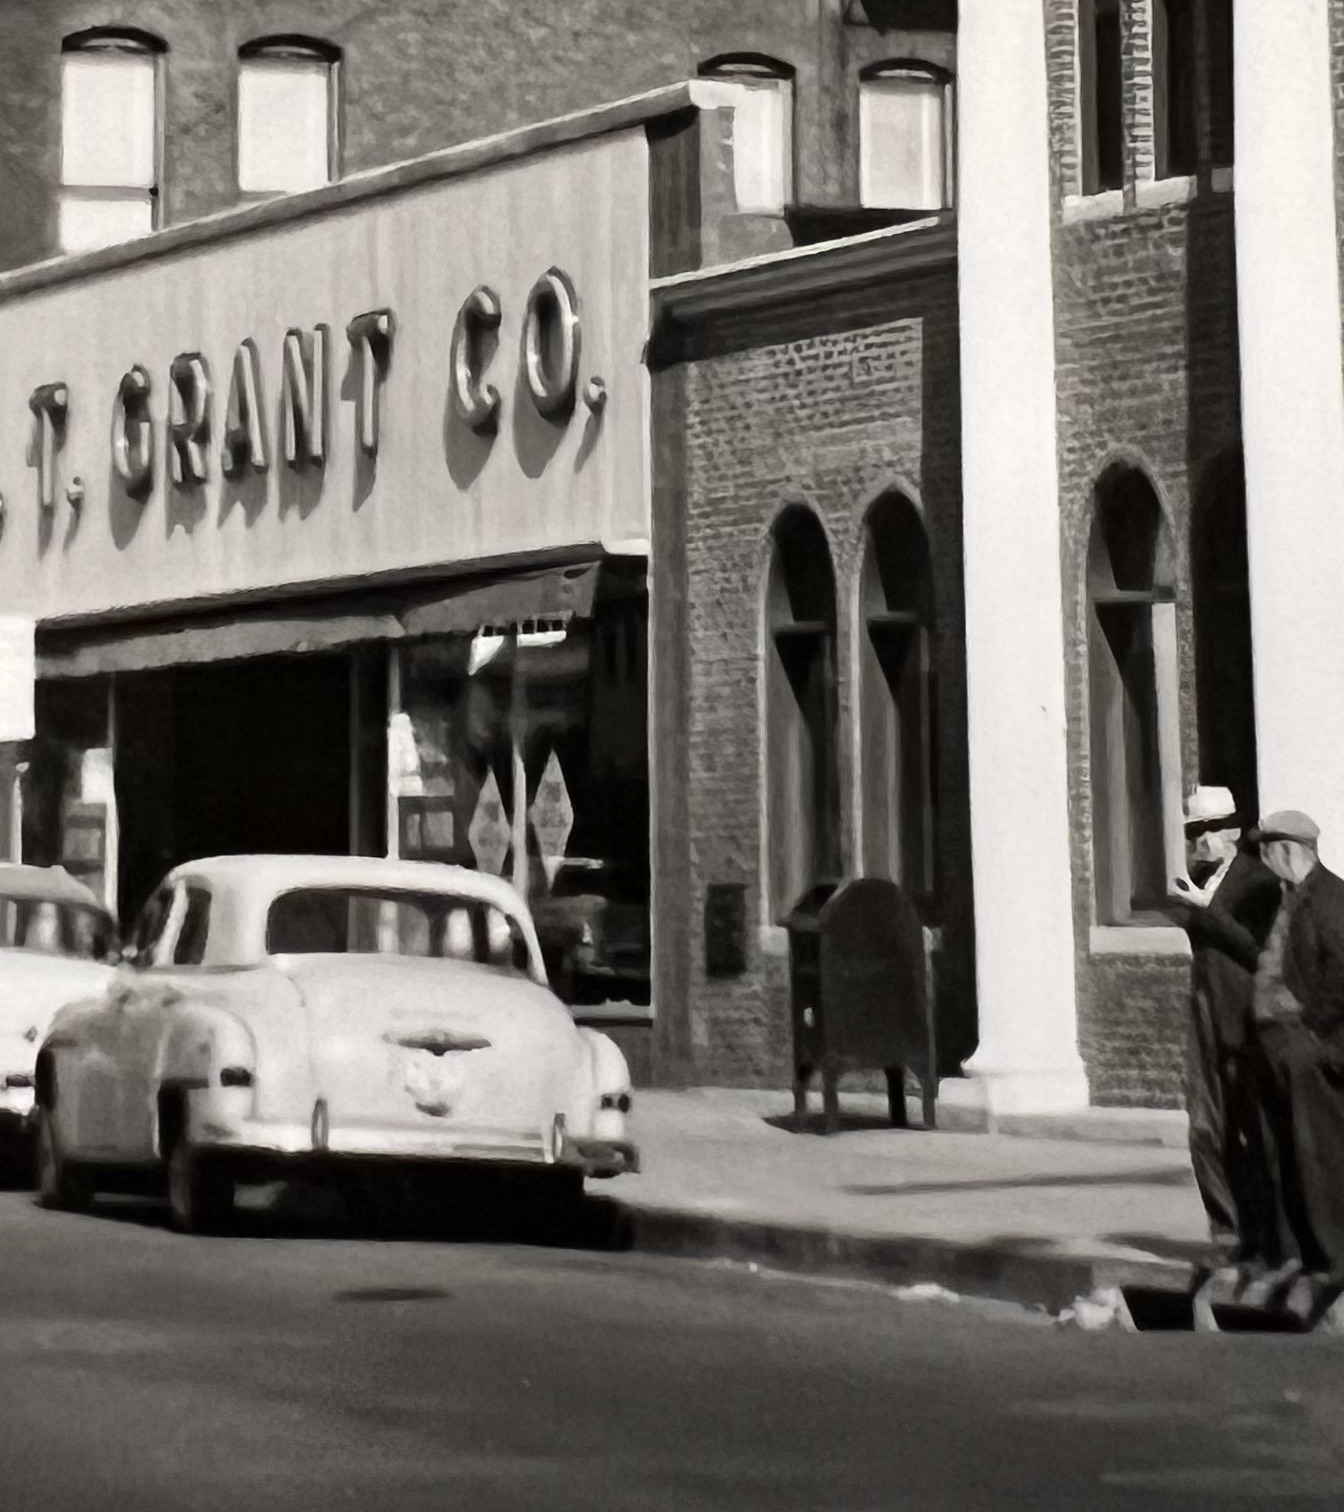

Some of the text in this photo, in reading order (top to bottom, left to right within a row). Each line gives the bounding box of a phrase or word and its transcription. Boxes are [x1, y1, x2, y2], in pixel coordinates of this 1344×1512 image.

[26, 381, 85, 515] T.
[110, 307, 398, 506] GRANT
[449, 265, 608, 441] CO.
